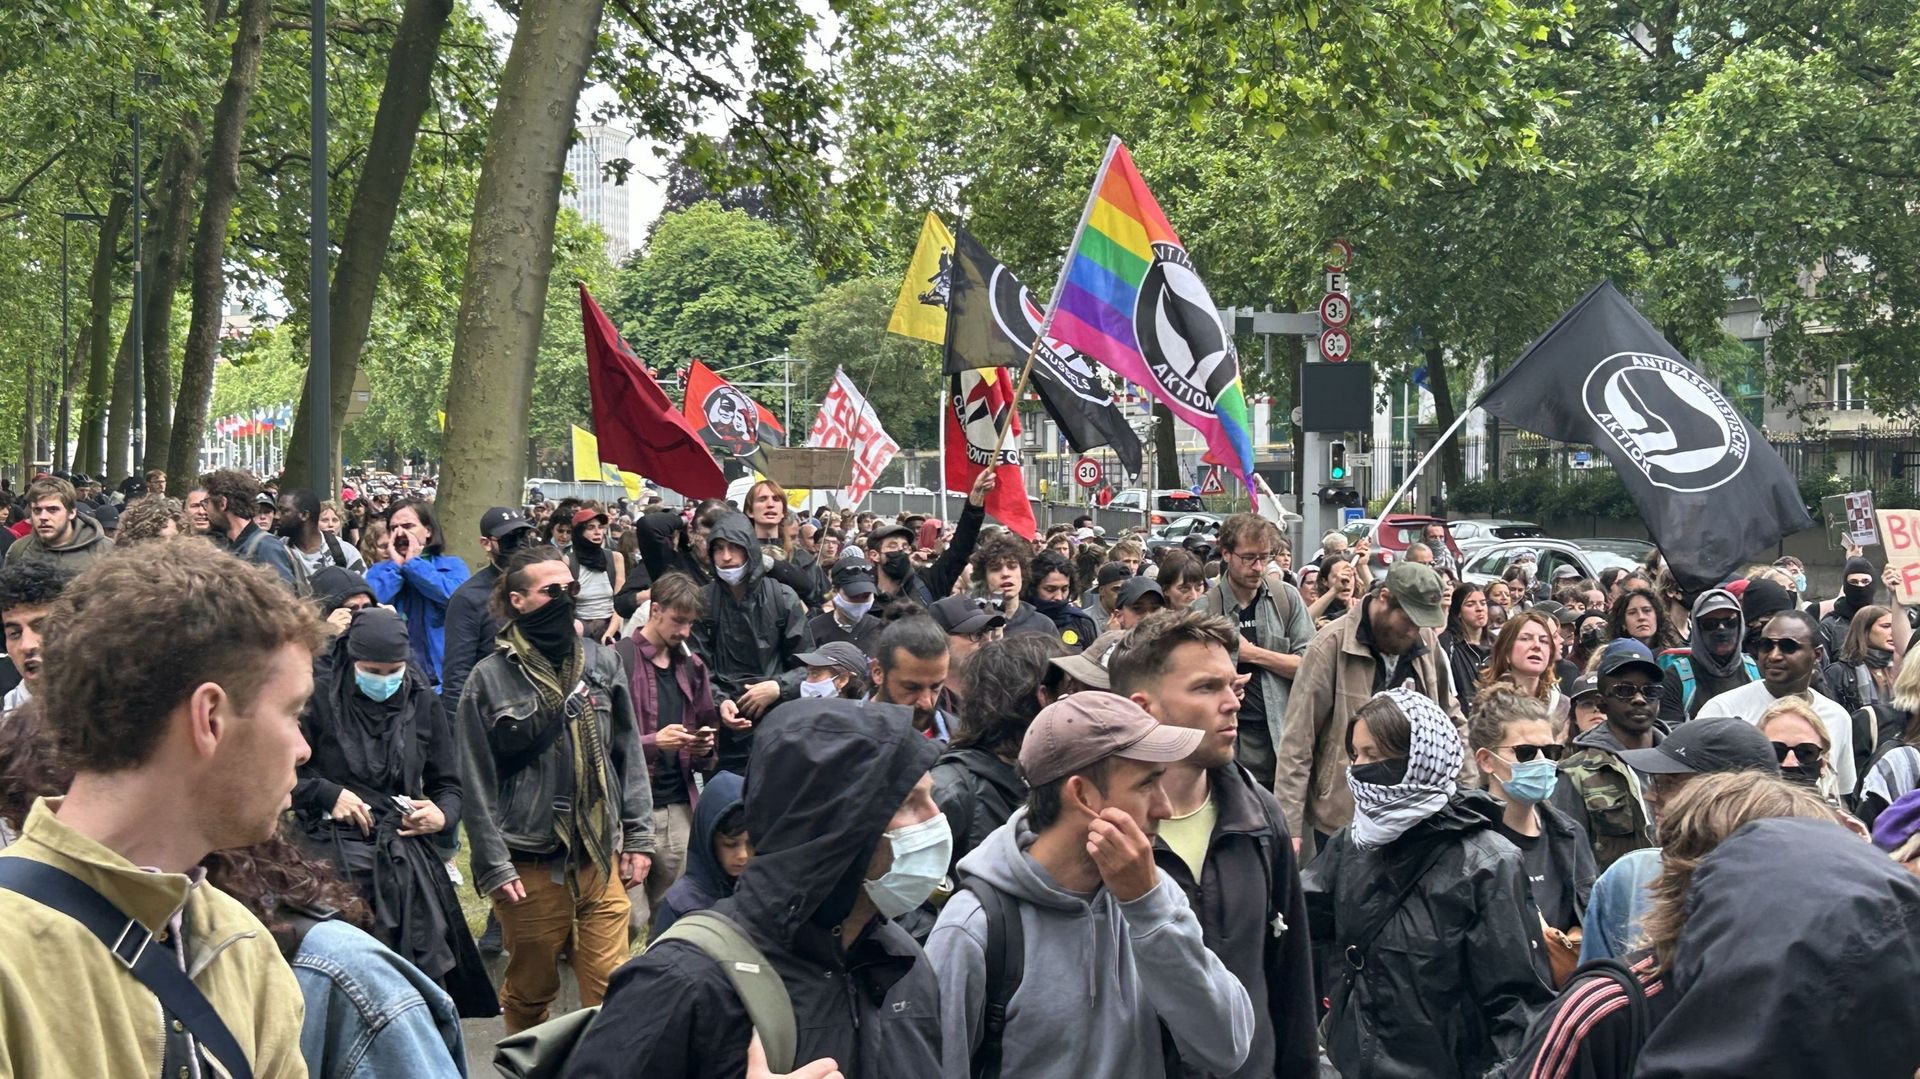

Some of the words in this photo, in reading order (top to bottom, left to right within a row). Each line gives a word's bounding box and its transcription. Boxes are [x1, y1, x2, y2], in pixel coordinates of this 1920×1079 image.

[1331, 274, 1341, 291] E
[1153, 363, 1215, 411] AKTION
[1631, 355, 1746, 460] ANTIFASCHISTISCHE
[1080, 466, 1096, 478] 30
